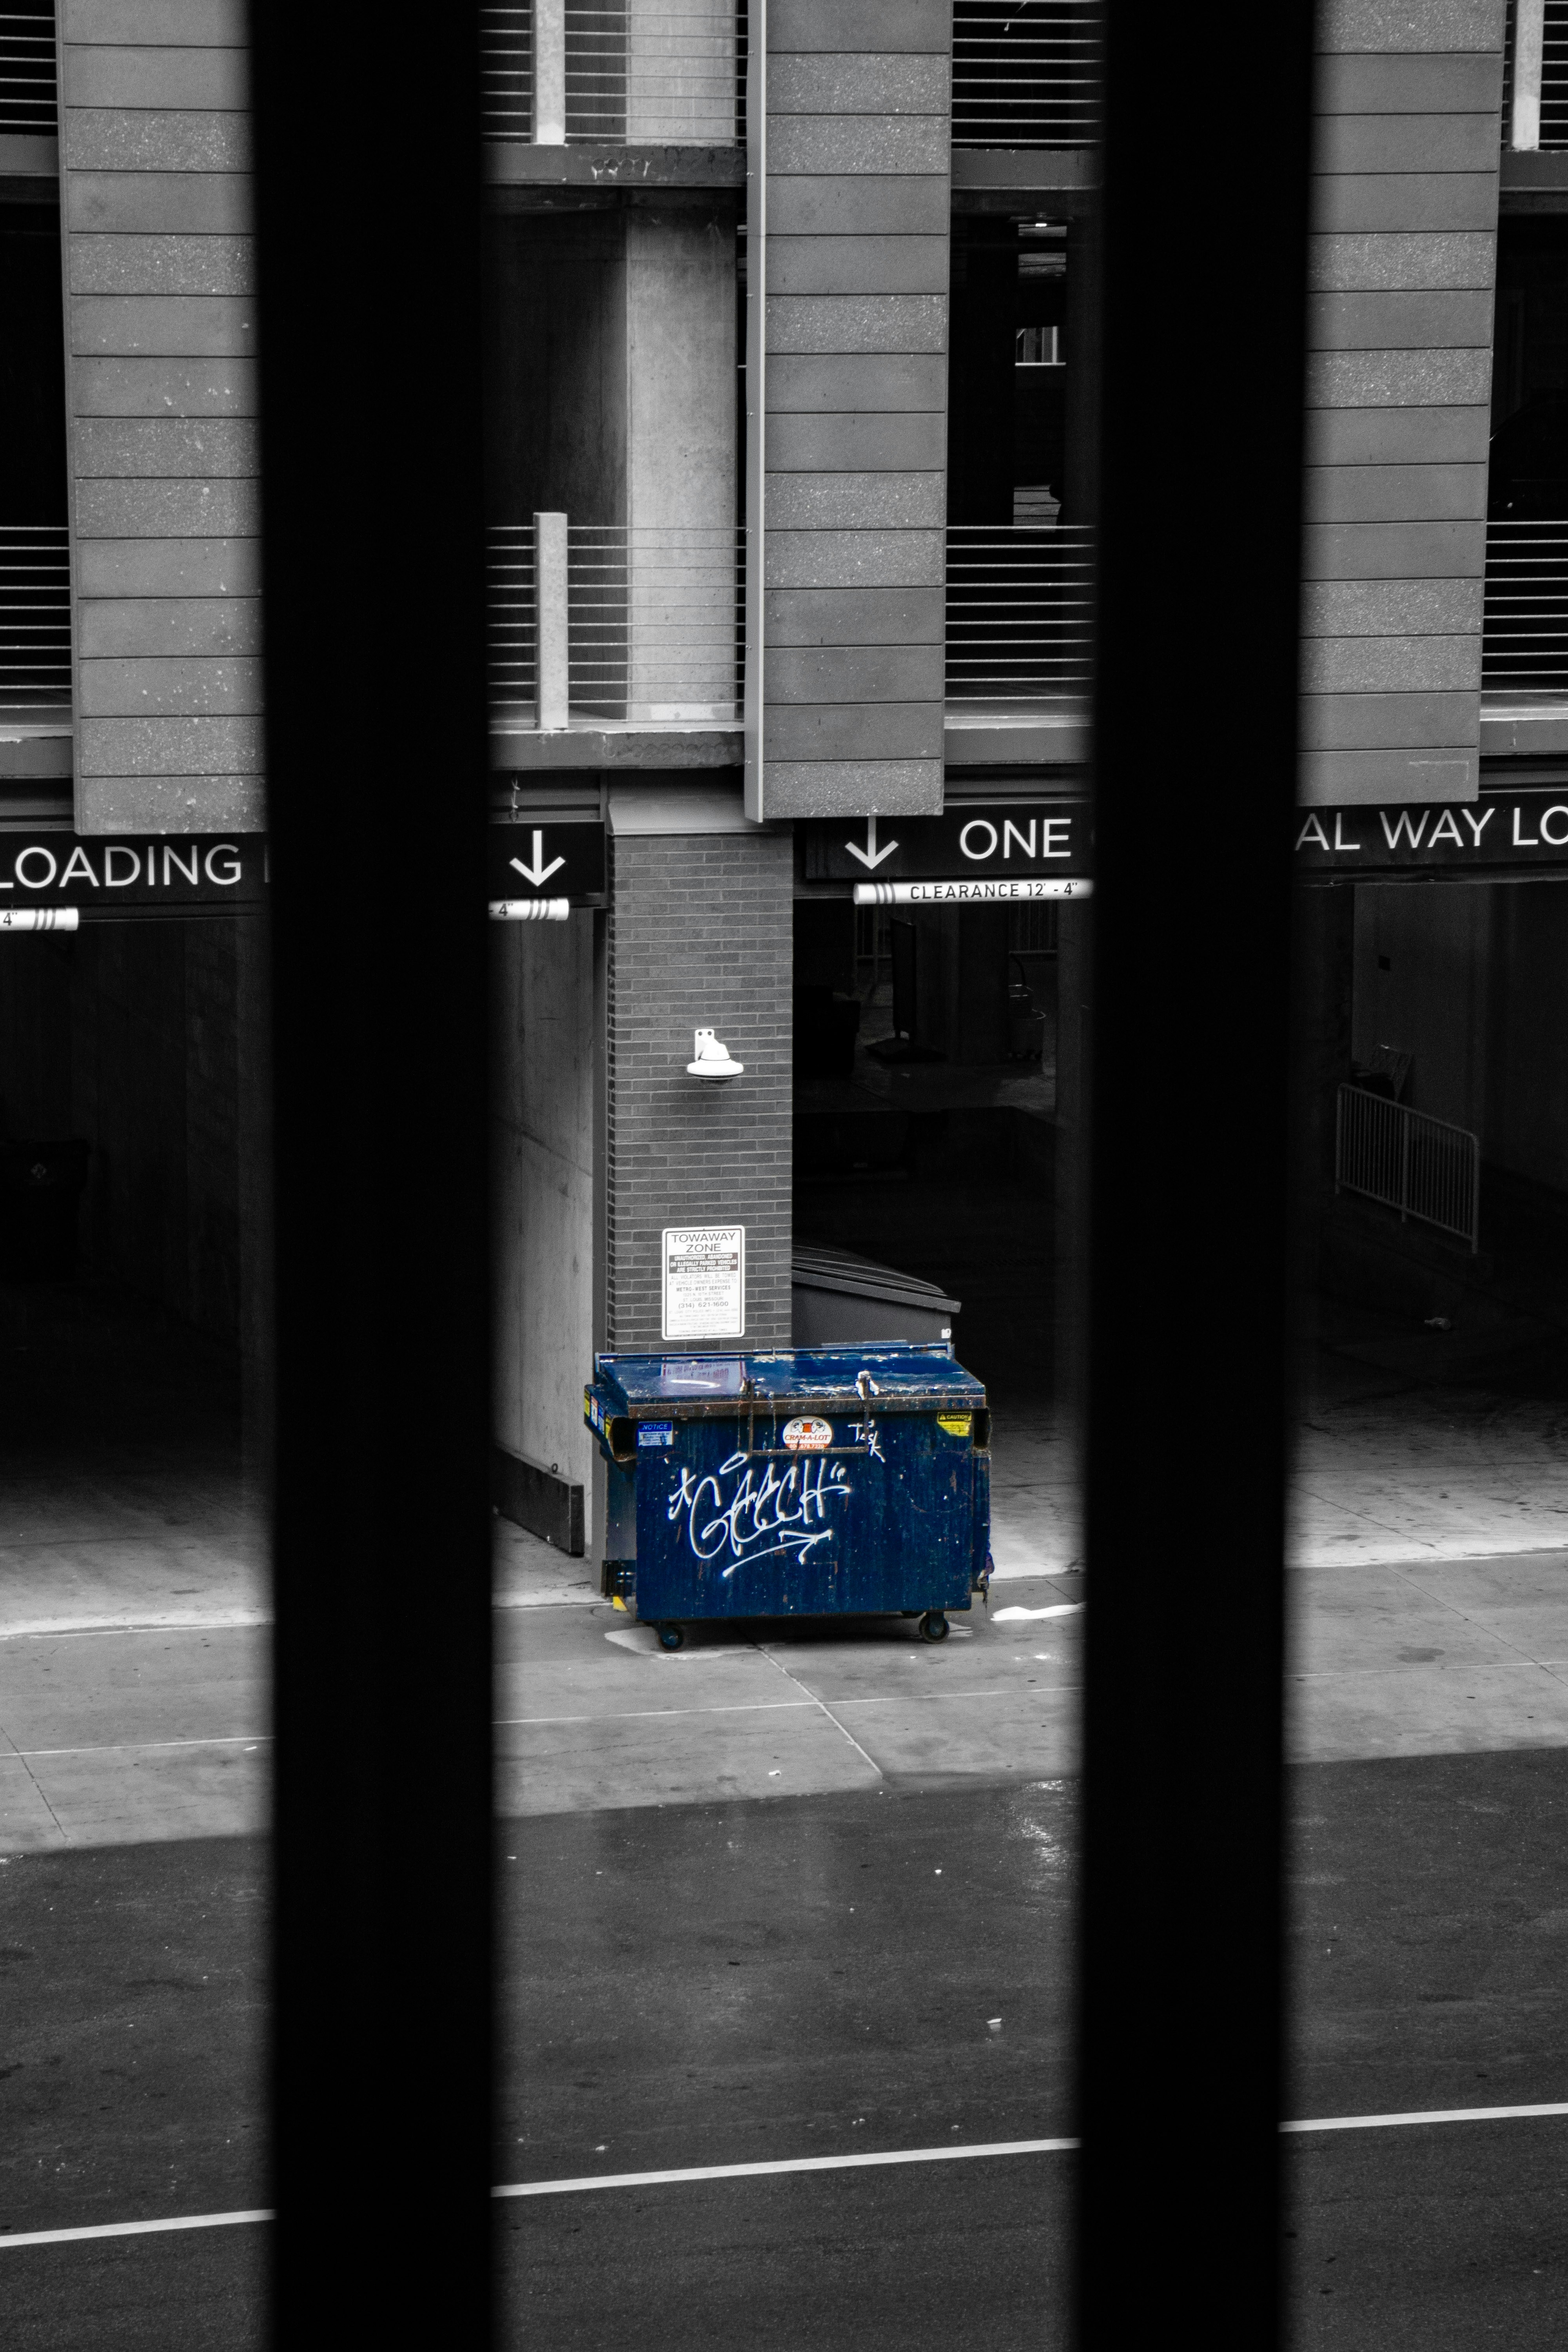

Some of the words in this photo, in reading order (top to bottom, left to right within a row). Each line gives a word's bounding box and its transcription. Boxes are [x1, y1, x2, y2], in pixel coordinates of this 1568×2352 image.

[1379, 808, 1495, 849] WAY
[960, 818, 1072, 860] ONE
[910, 884, 1020, 900] CLEARANCE
[1027, 883, 1046, 896] 12'
[671, 1232, 736, 1243] TOWAWAY
[686, 1243, 722, 1253] ZONE
